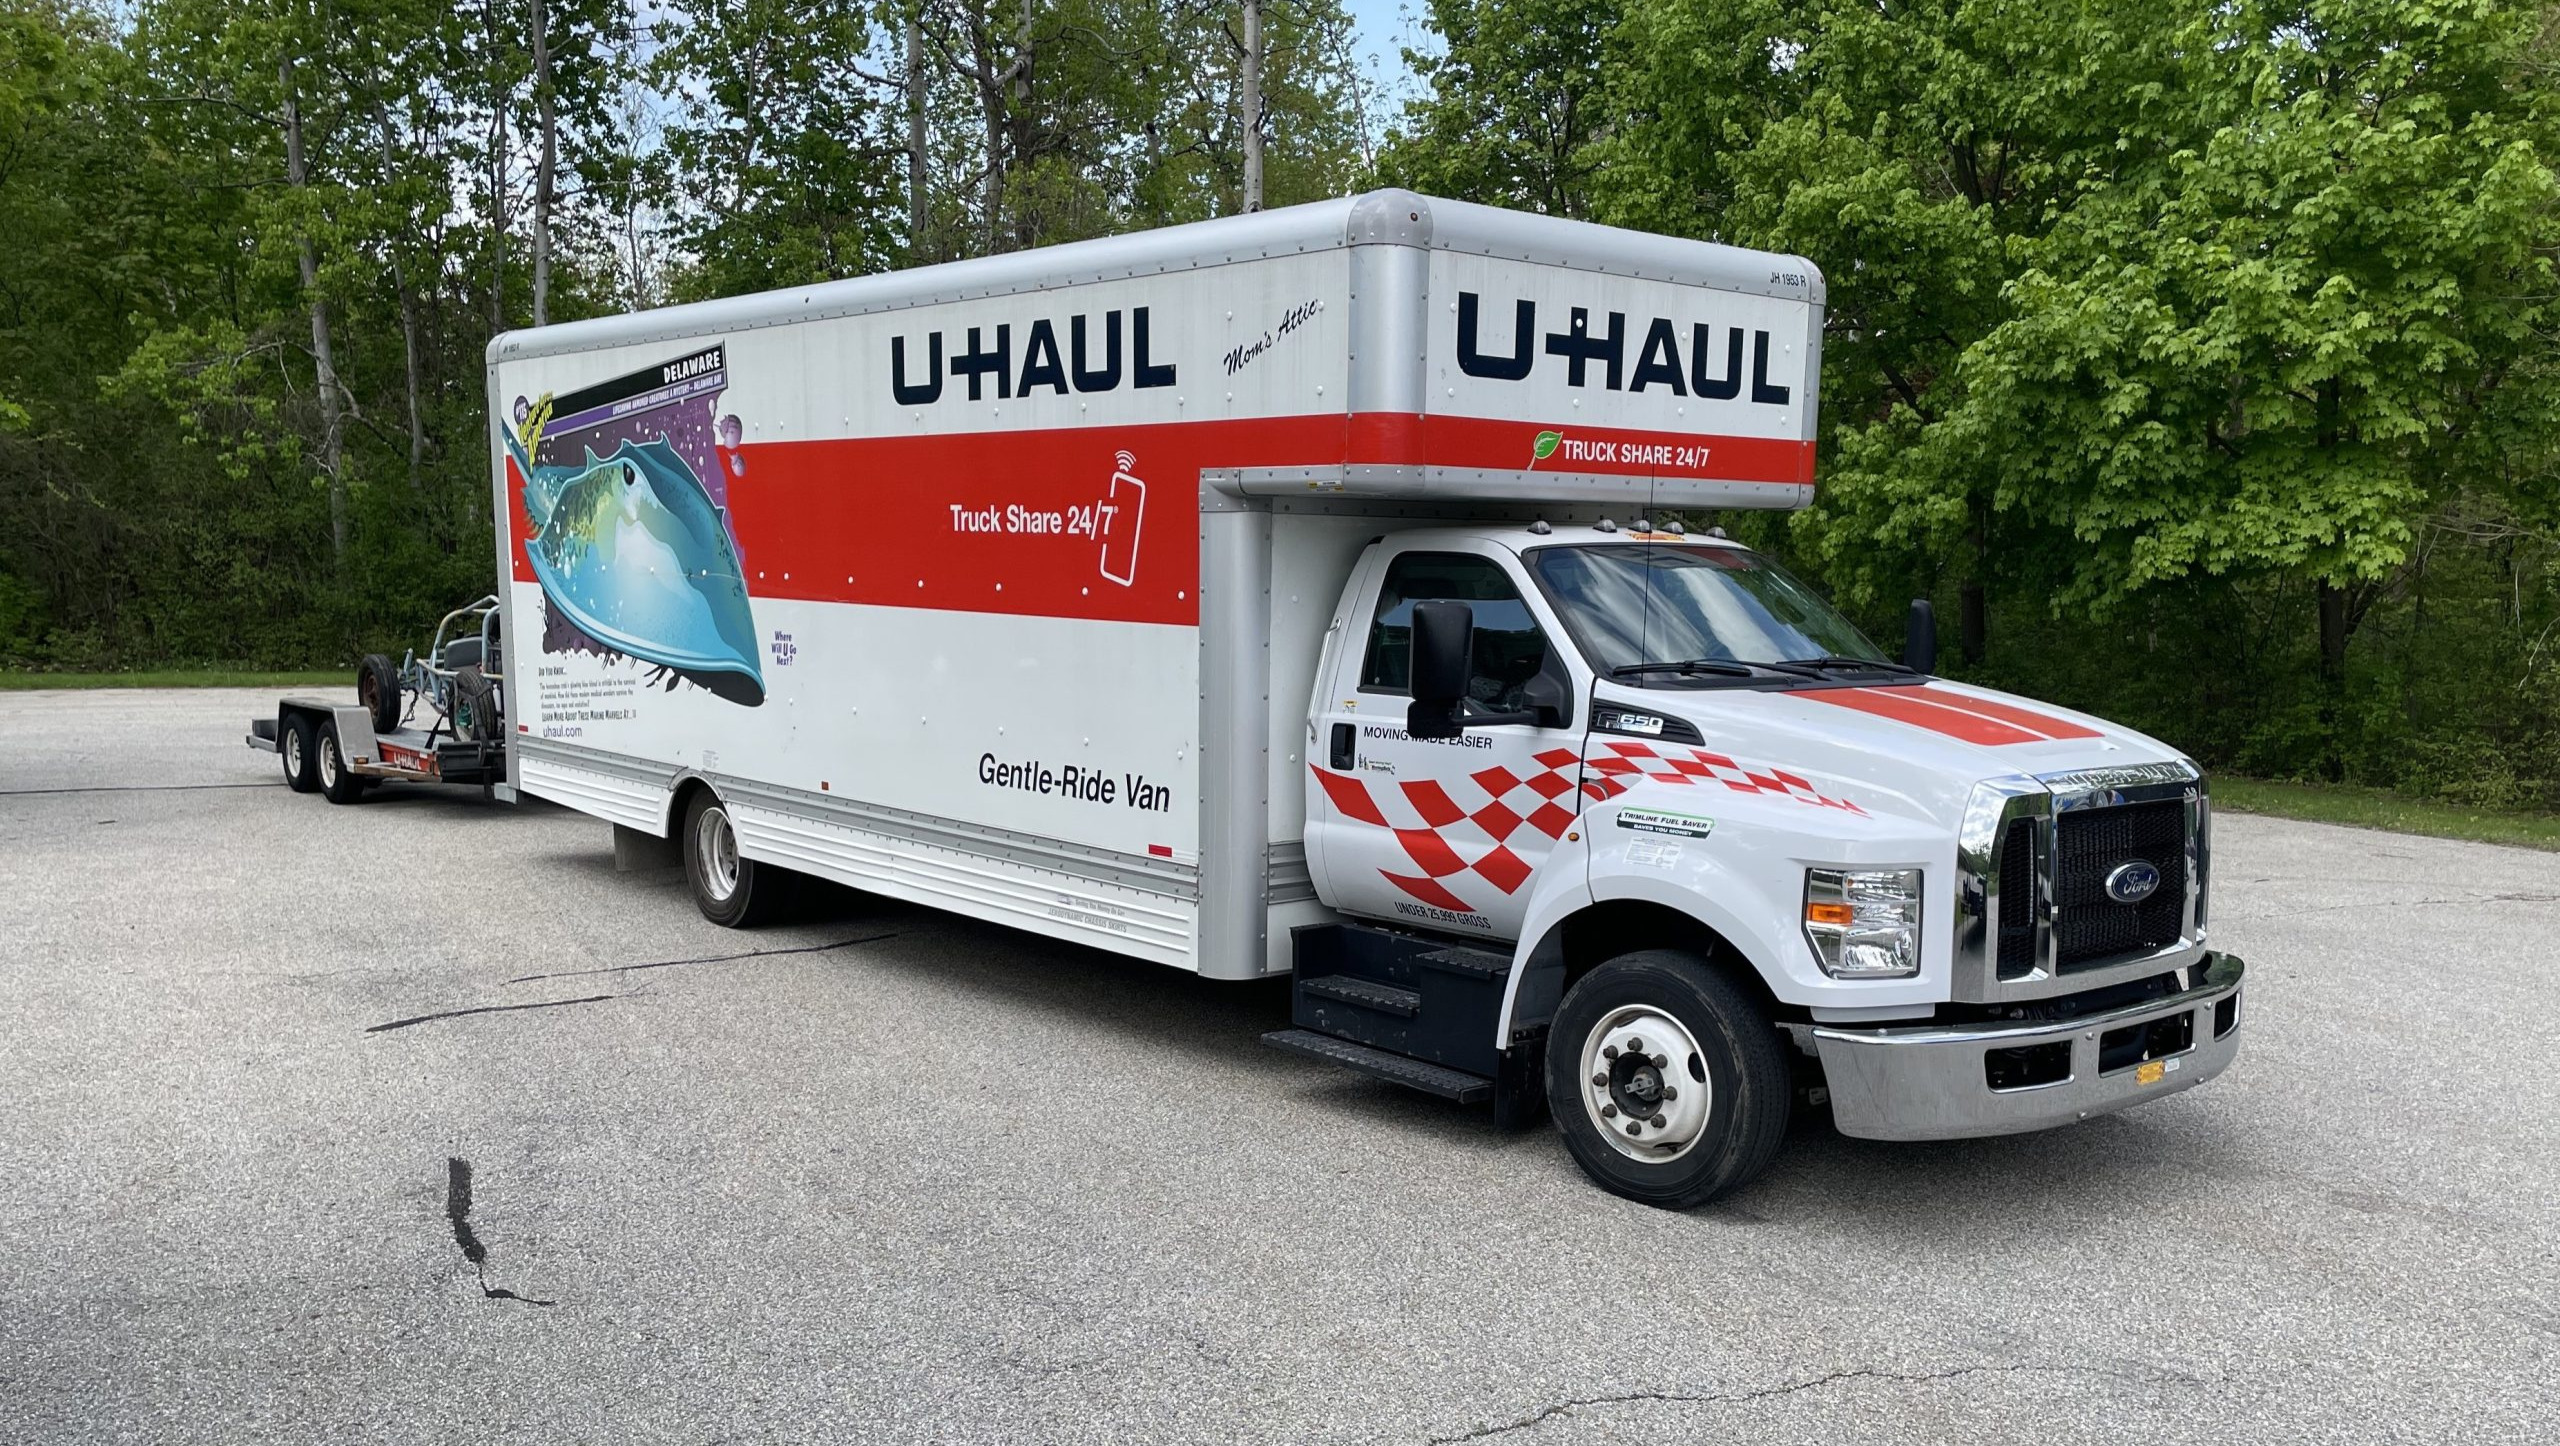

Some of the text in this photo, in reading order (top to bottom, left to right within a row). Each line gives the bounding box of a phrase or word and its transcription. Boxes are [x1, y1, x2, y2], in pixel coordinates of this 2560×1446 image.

[1770, 272, 1807, 287] JH 1953 R
[1223, 299, 1318, 376] Mom's Attic
[1457, 291, 1790, 405] U-HAUL
[663, 351, 720, 384] DELAWARE
[892, 307, 1176, 405] U-HAUL
[1562, 439, 1617, 462] TRUCK
[1621, 443, 1672, 466] SHARE
[950, 504, 1001, 532] Truck
[1006, 504, 1063, 534] Share
[774, 630, 792, 642] Where
[771, 642, 797, 657] Will U Go
[543, 724, 582, 738] uhaul.com
[1363, 726, 1409, 741] MOVING
[1449, 735, 1493, 749] EASIER
[979, 752, 1170, 812] Gentle-Ride Van
[1624, 812, 1707, 829] TRIMLINE FUEL SAVER
[1669, 828, 1693, 837] MONEY
[2123, 870, 2152, 895] Ford
[1394, 901, 1492, 930] UNDER 25,999 GROSS
